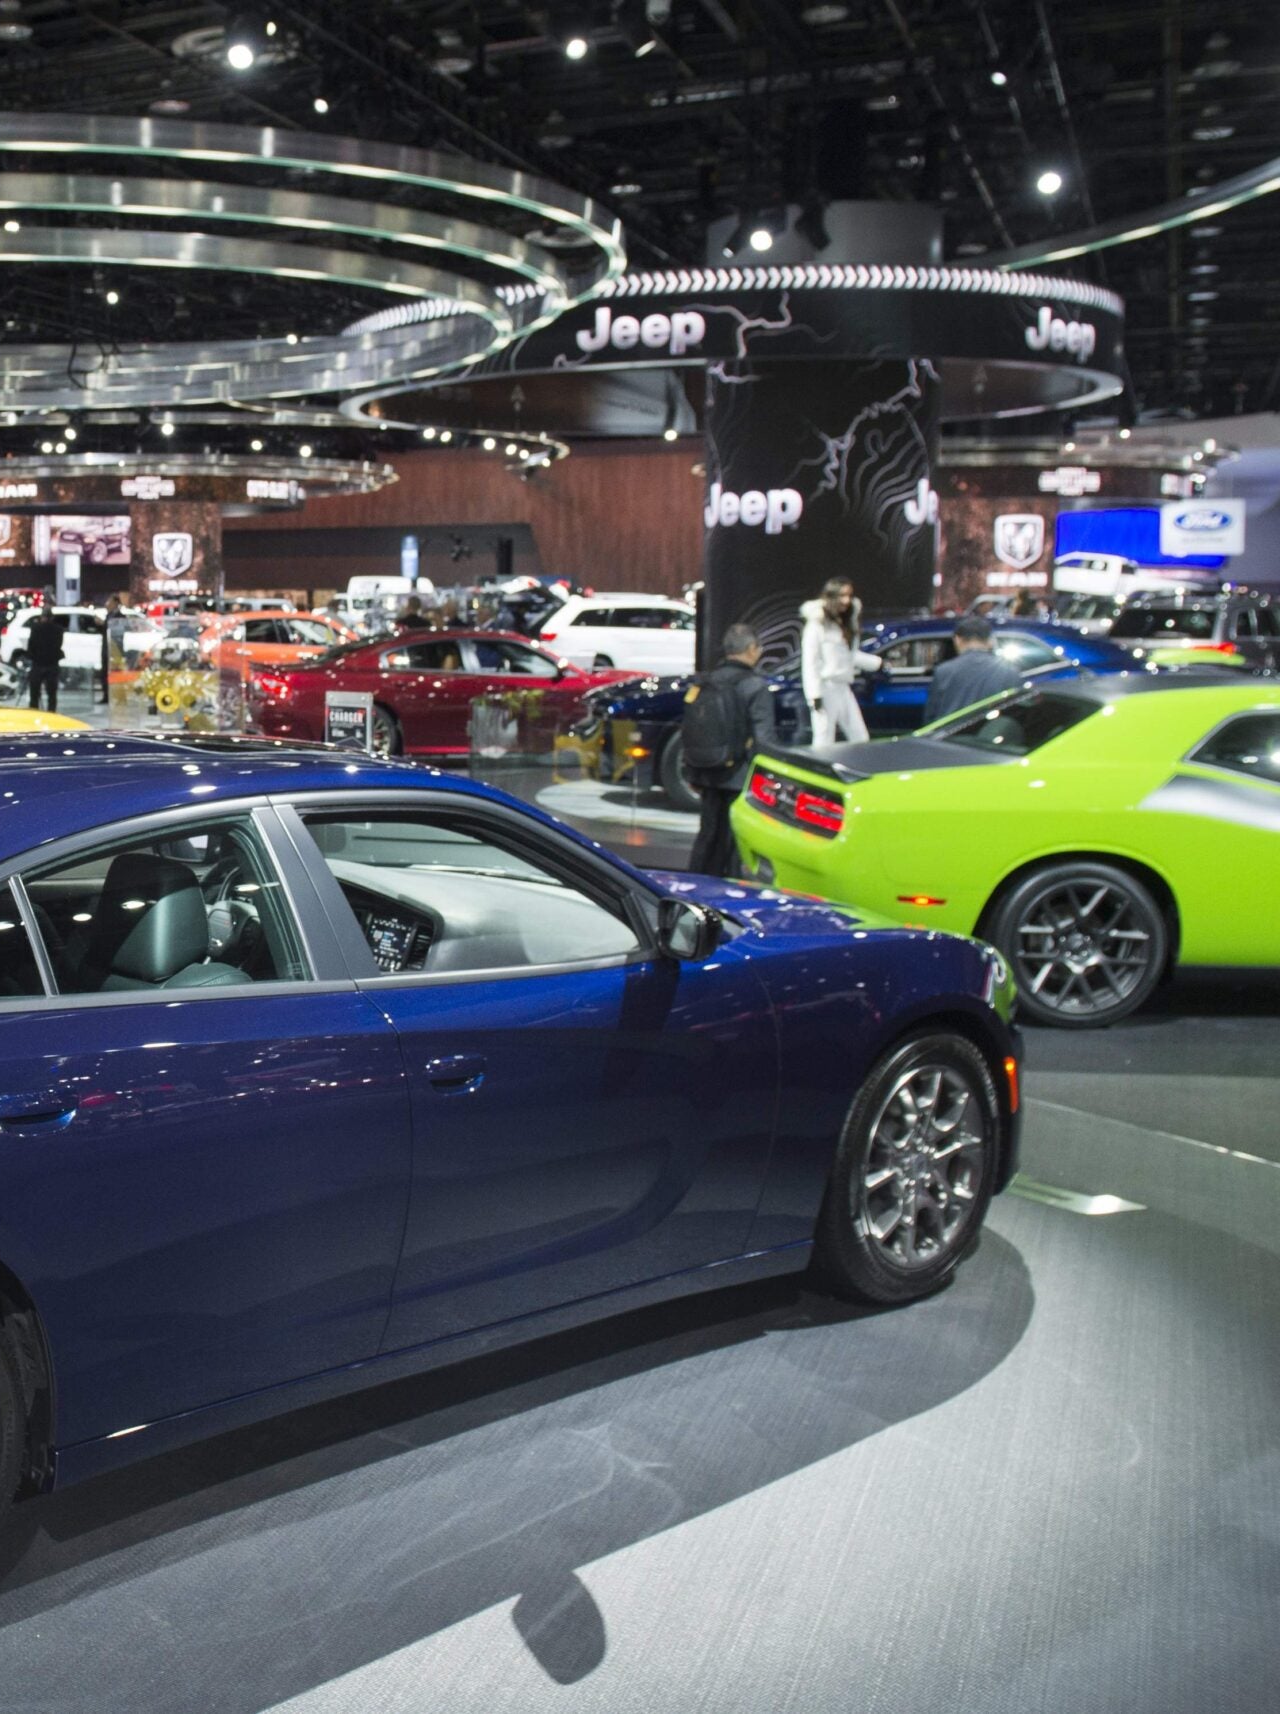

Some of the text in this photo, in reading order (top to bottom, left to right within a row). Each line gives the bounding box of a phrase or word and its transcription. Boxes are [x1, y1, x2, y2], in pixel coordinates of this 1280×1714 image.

[577, 307, 705, 354] Jeep
[1026, 307, 1096, 362] Jeep
[704, 482, 803, 535] Jeep
[329, 711, 363, 723] CHARGER
